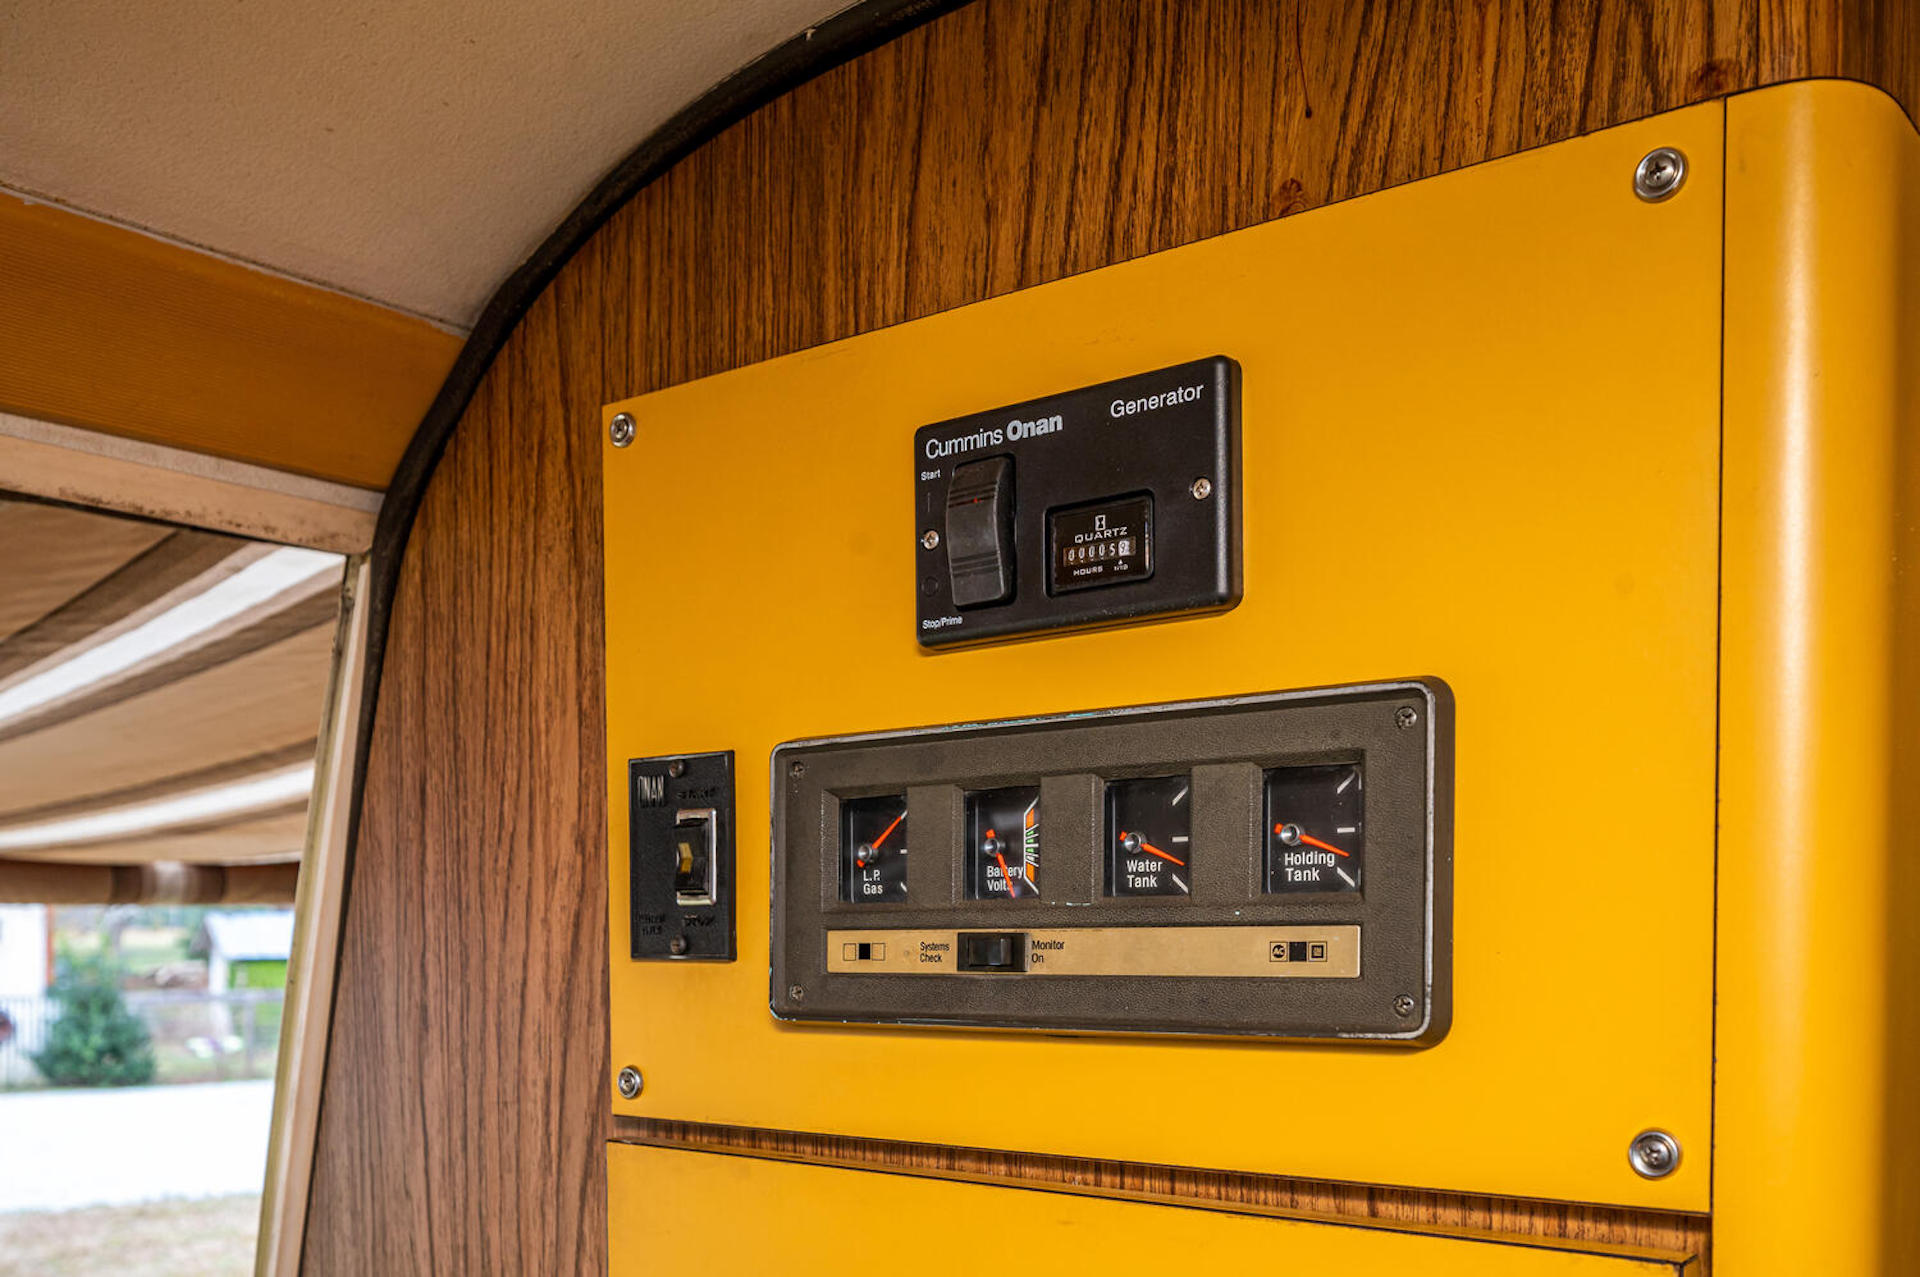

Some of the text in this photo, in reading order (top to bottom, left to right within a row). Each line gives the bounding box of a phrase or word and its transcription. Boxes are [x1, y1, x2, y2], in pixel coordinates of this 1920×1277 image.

[1110, 383, 1204, 418] Generator
[925, 414, 1063, 459] Cummins Onan
[920, 469, 941, 481] Start
[1074, 526, 1128, 544] QUARTZ
[1073, 565, 1103, 576] HOURS
[922, 616, 963, 629] Stop/Prime
[1284, 852, 1335, 867] Holding
[986, 865, 1024, 879] Batery
[1126, 860, 1163, 872] Water
[1285, 867, 1320, 882] Tank
[1127, 875, 1158, 887] Tank
[863, 883, 883, 895] Gas
[919, 941, 950, 952] Systems
[1031, 940, 1065, 951] Monitor
[919, 953, 943, 963] Check
[1031, 953, 1044, 964] On
